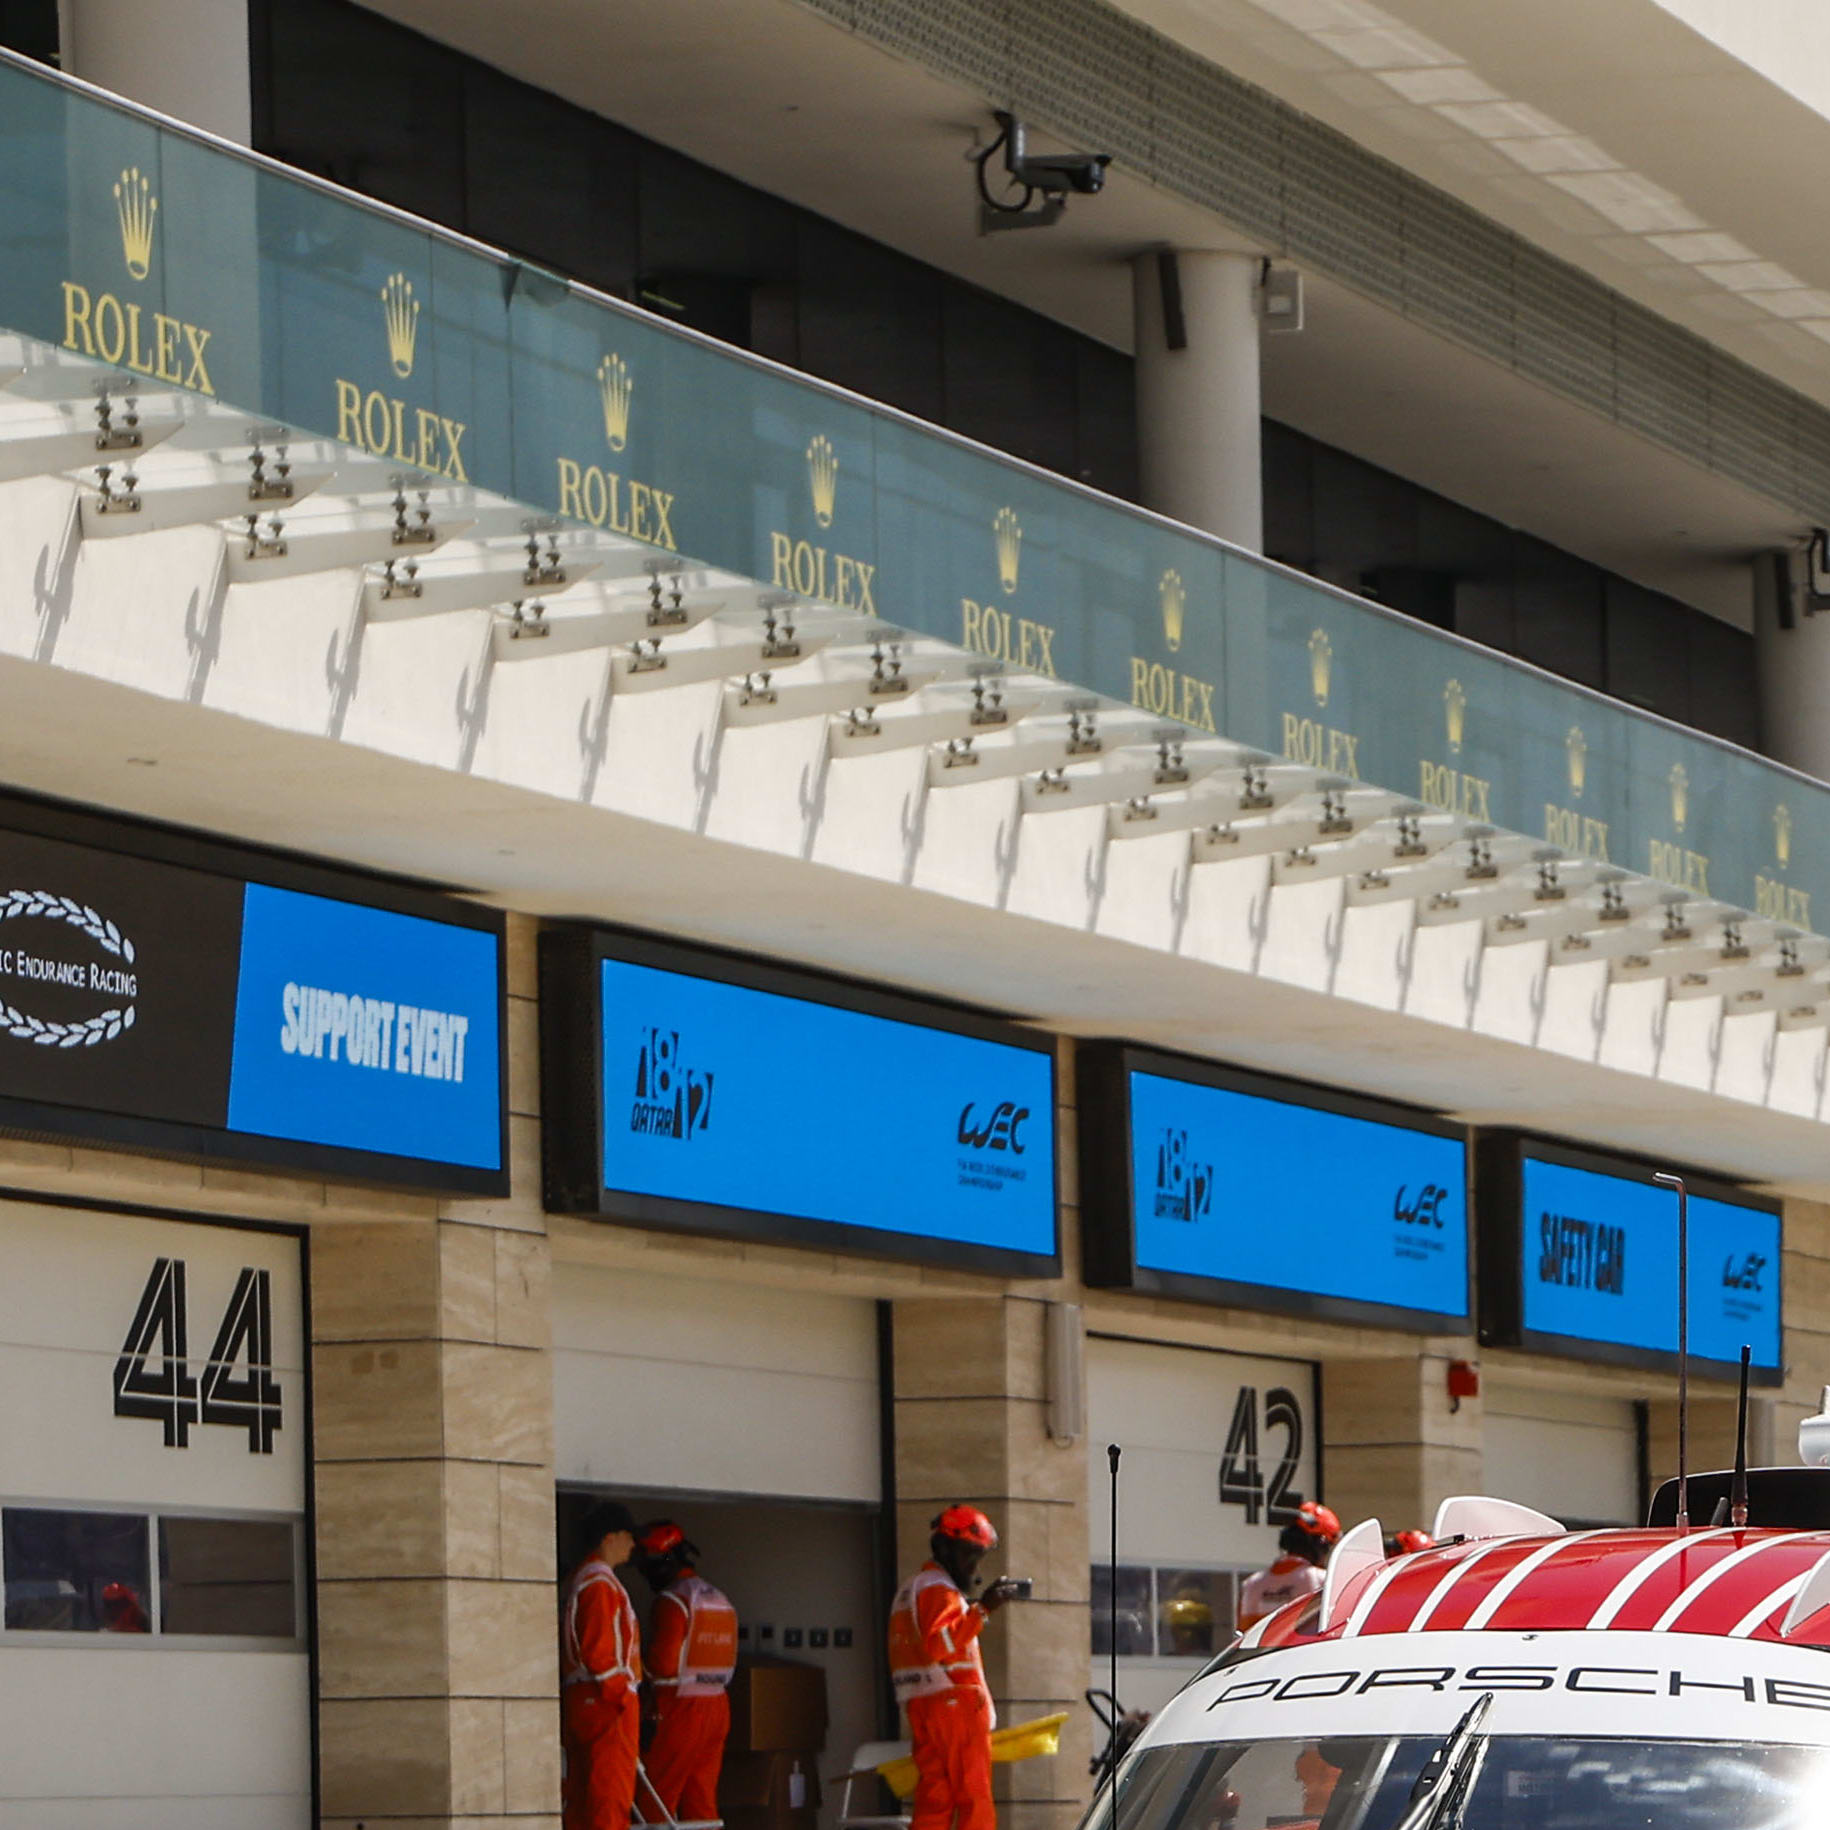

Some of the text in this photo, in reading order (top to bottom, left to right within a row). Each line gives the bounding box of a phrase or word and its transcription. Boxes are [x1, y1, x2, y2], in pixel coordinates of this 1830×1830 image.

[62, 281, 215, 396] ROLEX
[335, 378, 468, 483] ROLEX
[557, 457, 677, 552] ROLEX
[771, 531, 877, 617] ROLEX
[962, 599, 1055, 677] ROLEX
[1131, 658, 1215, 732] ROLEX
[1283, 713, 1358, 780] ROLEX
[1421, 760, 1490, 823] ROLEX
[1545, 804, 1609, 863] ROLEX
[1650, 839, 1709, 896] ROLEX
[17, 950, 86, 987] ENDURANCE
[90, 963, 137, 997] RACING
[281, 981, 468, 1083] SUPPORT EVENT
[630, 1101, 674, 1136] QATAR
[957, 1101, 1029, 1155] WEC
[1394, 1184, 1448, 1229] WEC
[1540, 1212, 1625, 1296] SAFETY CAR
[113, 1256, 282, 1455] 44
[1219, 1385, 1304, 1526] 42
